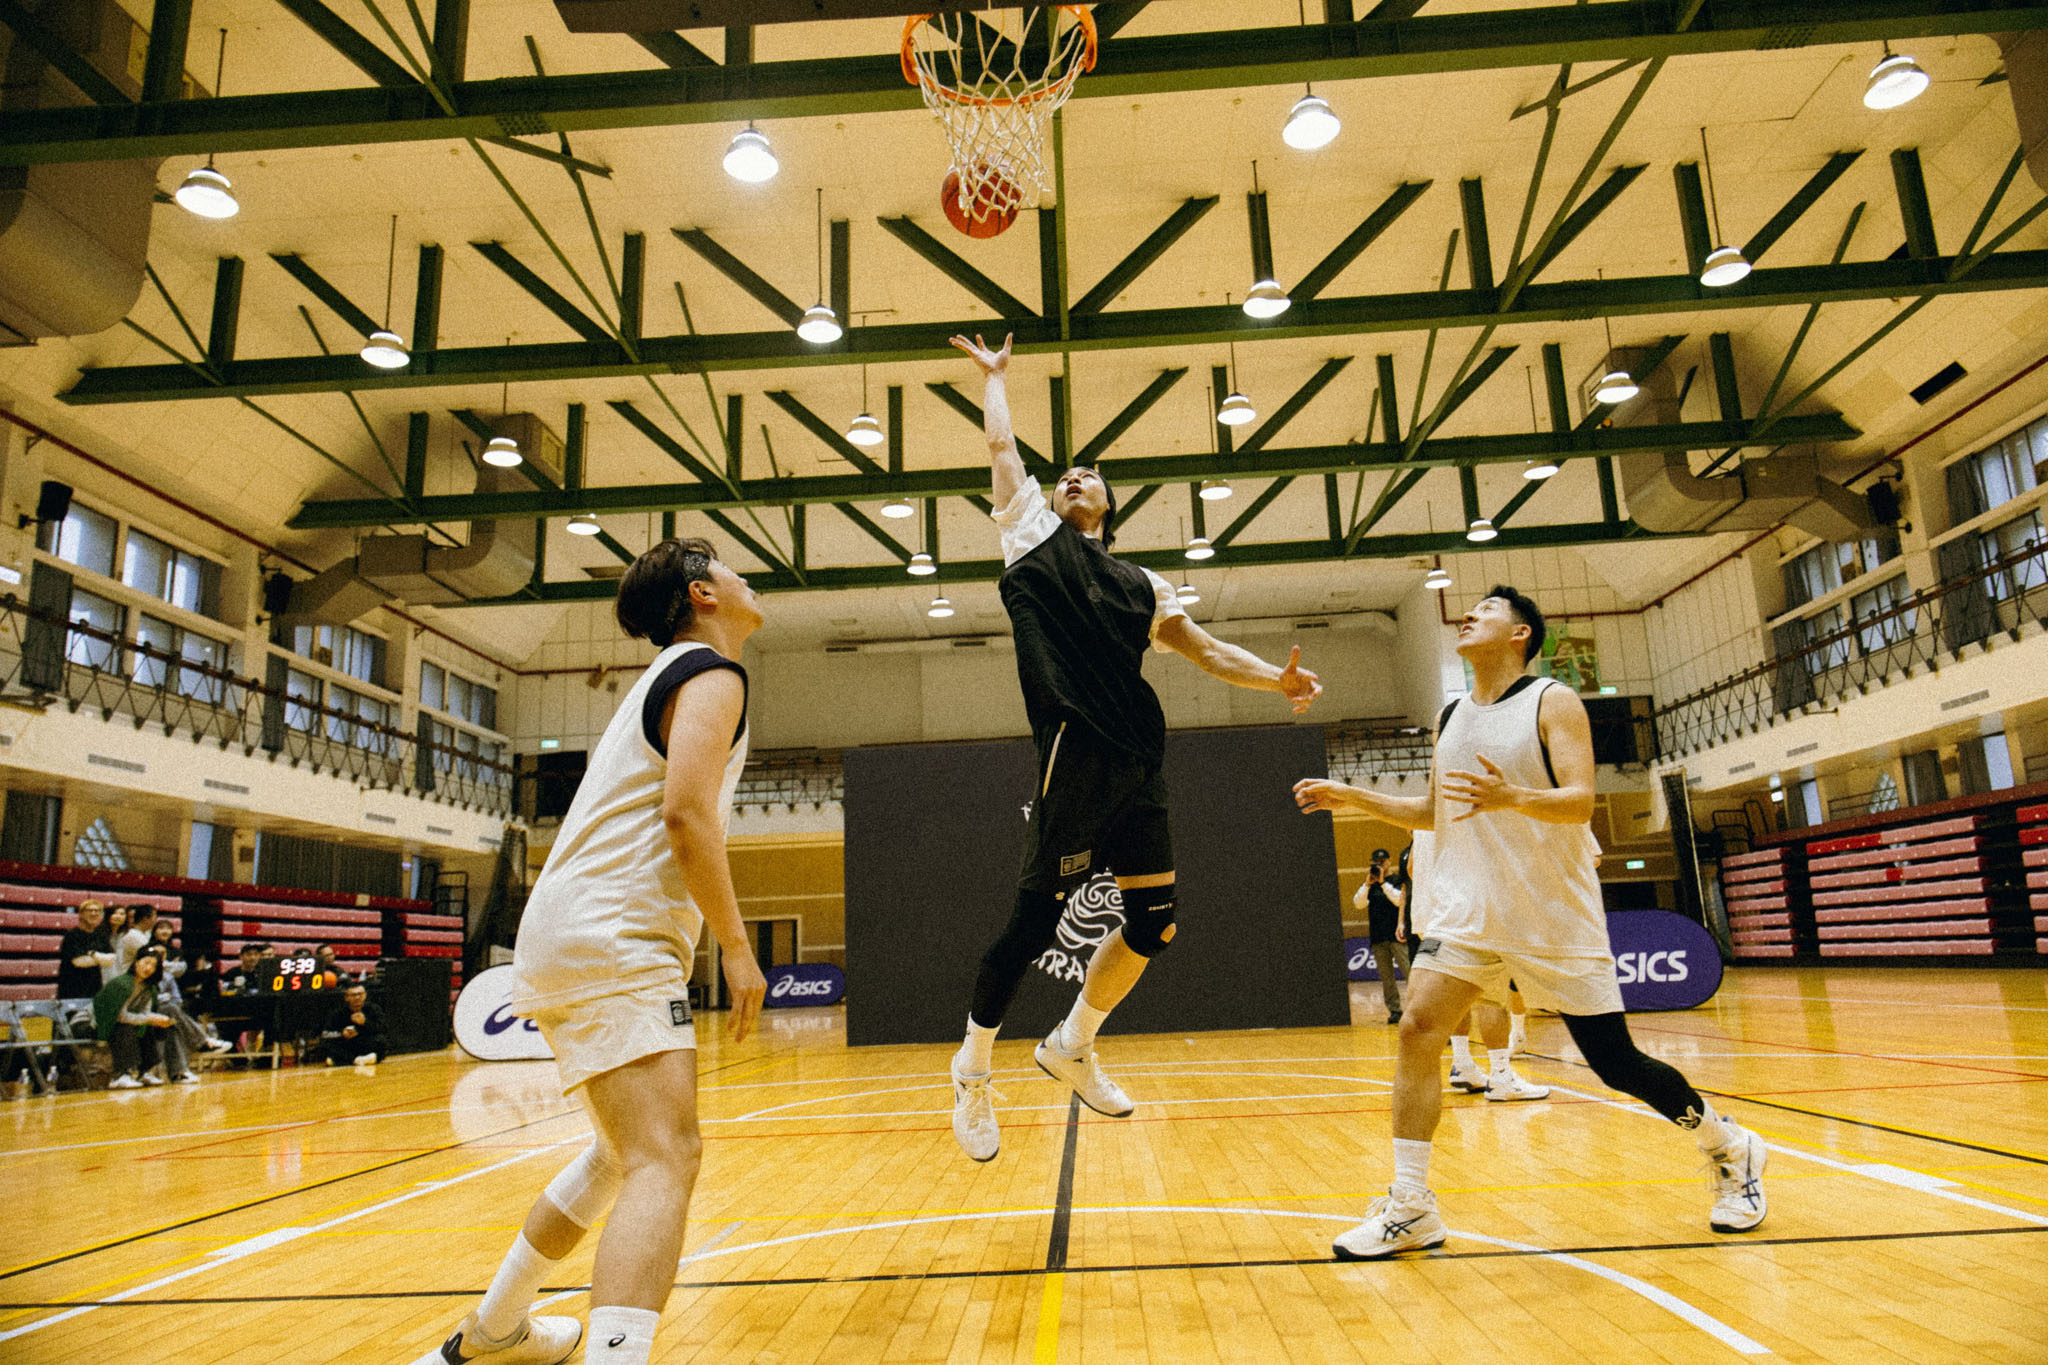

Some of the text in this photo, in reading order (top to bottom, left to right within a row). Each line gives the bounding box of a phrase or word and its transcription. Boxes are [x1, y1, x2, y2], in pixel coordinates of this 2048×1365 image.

[280, 958, 316, 975] 9:39
[1617, 950, 1688, 984] SICS
[272, 974, 323, 991] 0 5 0
